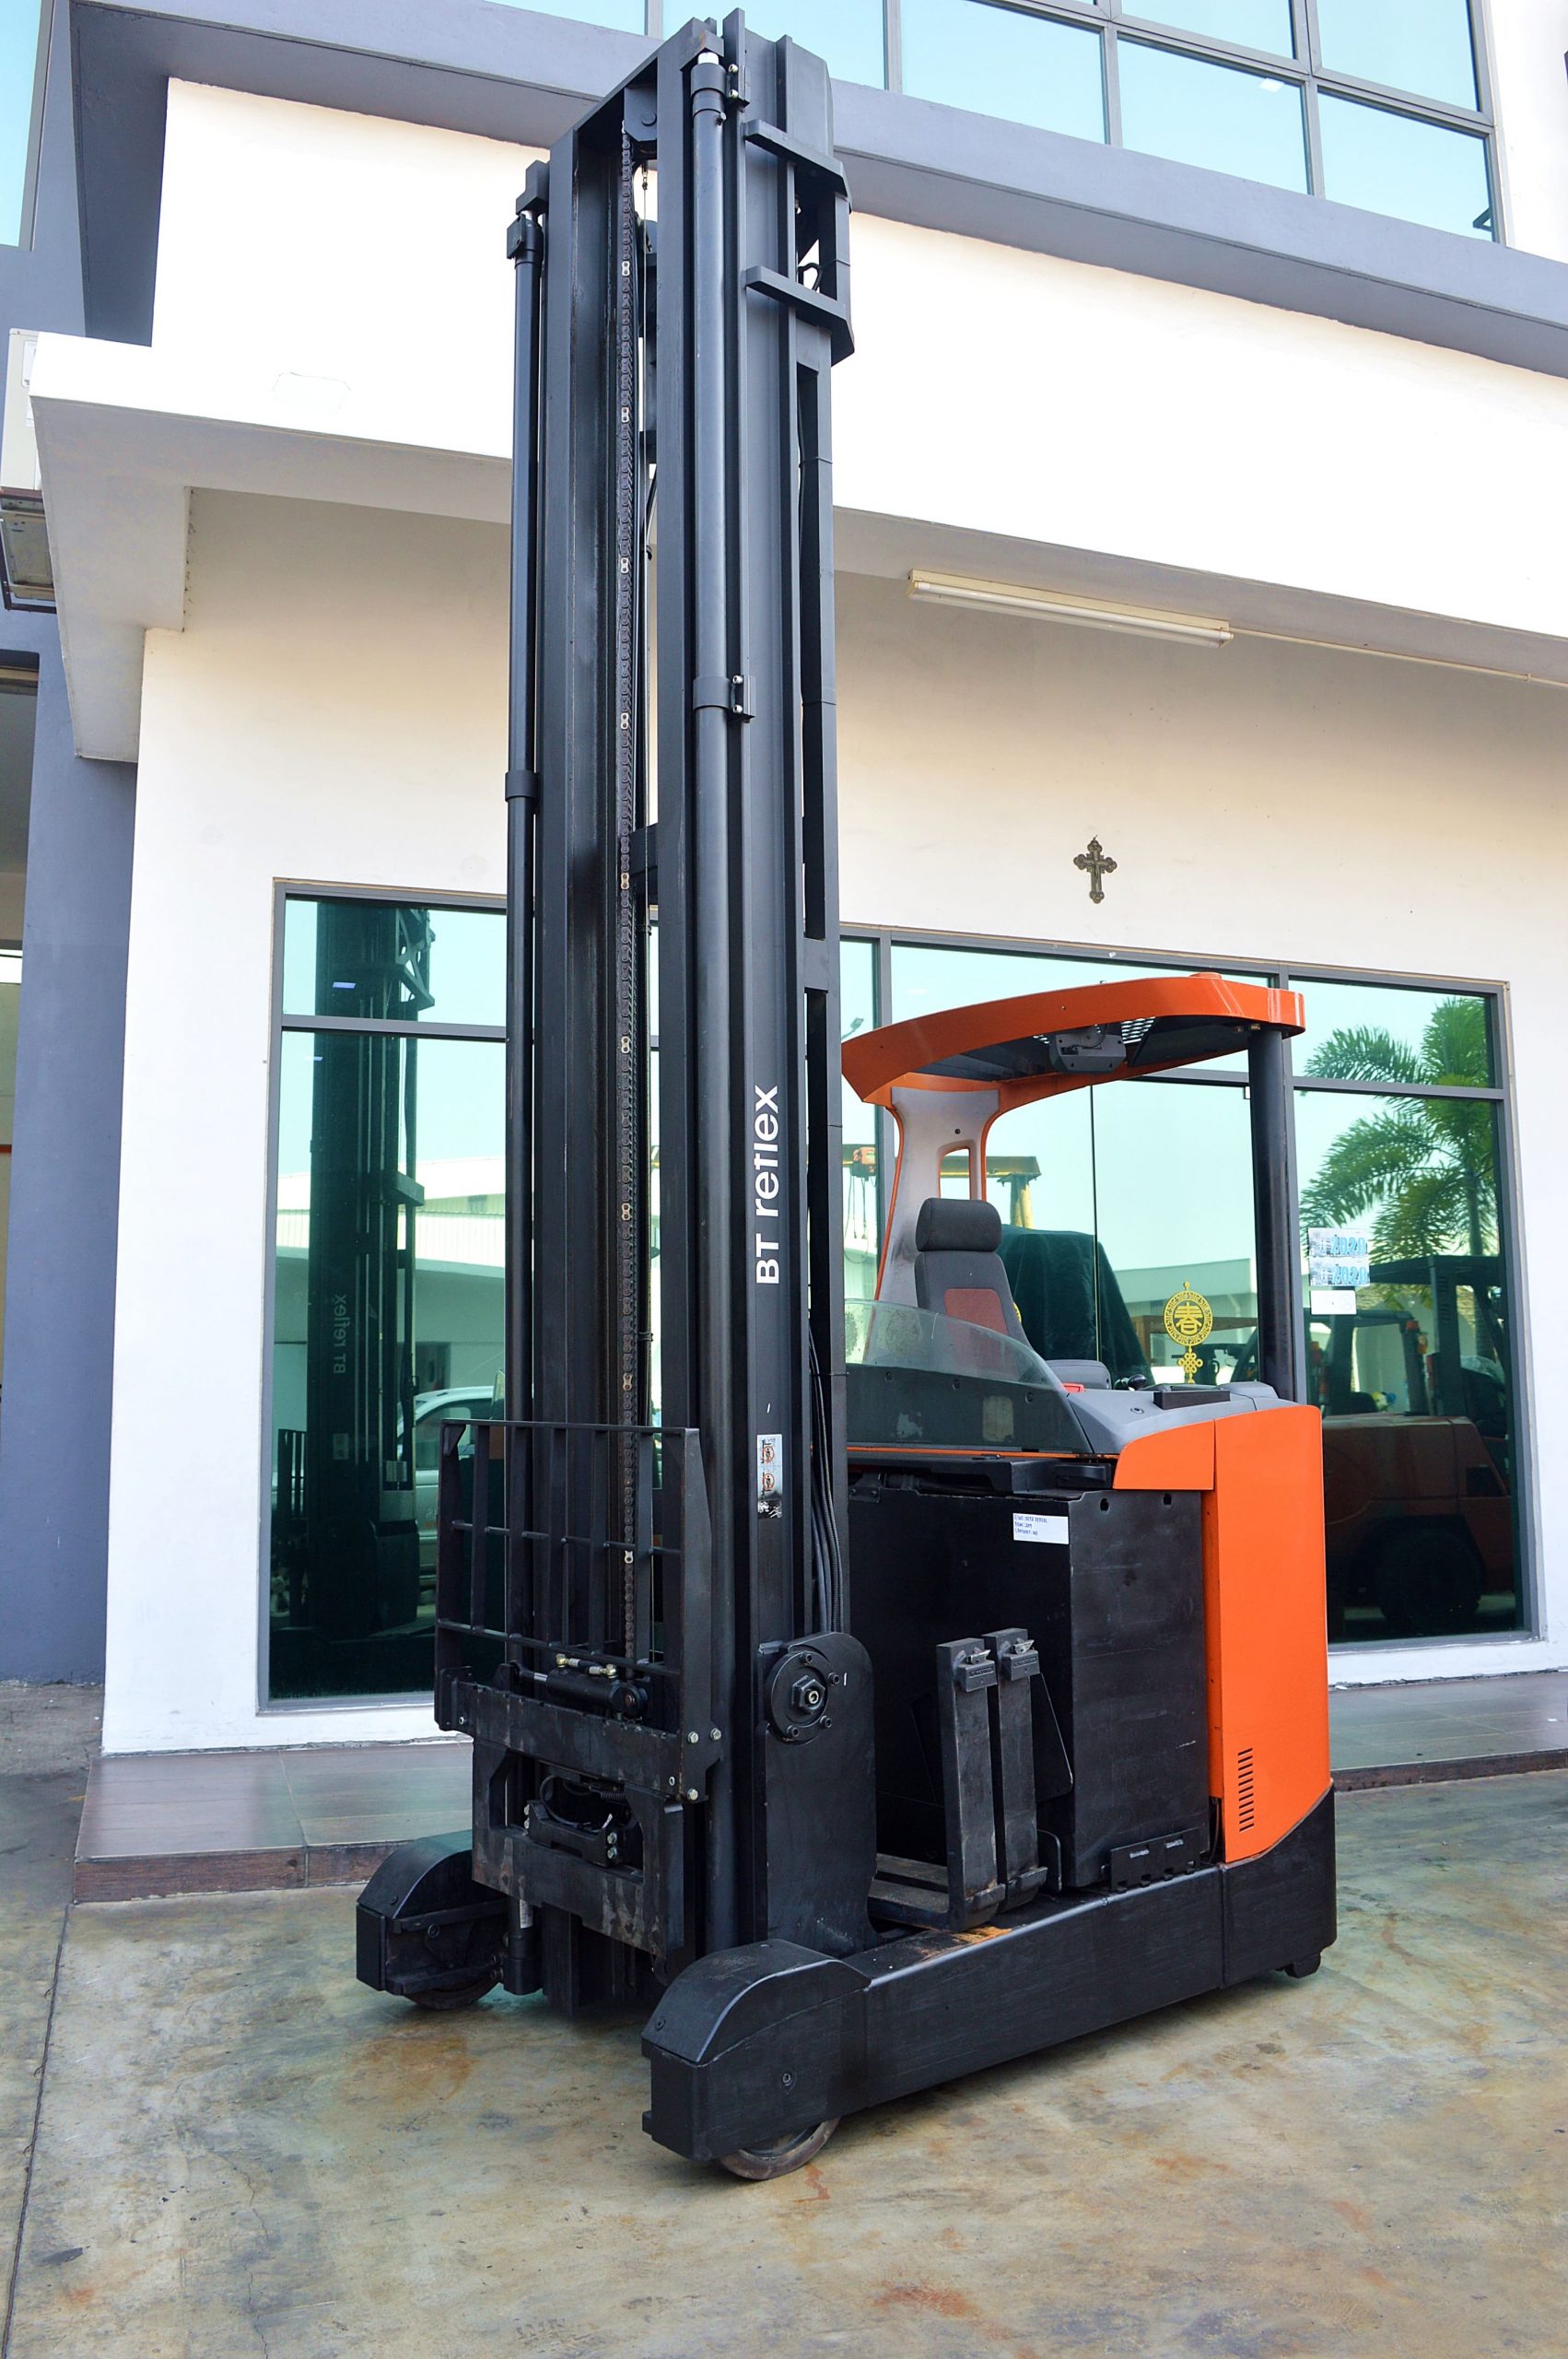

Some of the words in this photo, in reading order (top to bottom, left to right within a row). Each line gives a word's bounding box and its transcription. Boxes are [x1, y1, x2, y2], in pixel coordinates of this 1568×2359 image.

[754, 1085, 779, 1217] reflex
[755, 1233, 779, 1285] BT
[1330, 1237, 1366, 1254] 2020
[1331, 1266, 1368, 1284] 2020
[1174, 1301, 1203, 1335] 春
